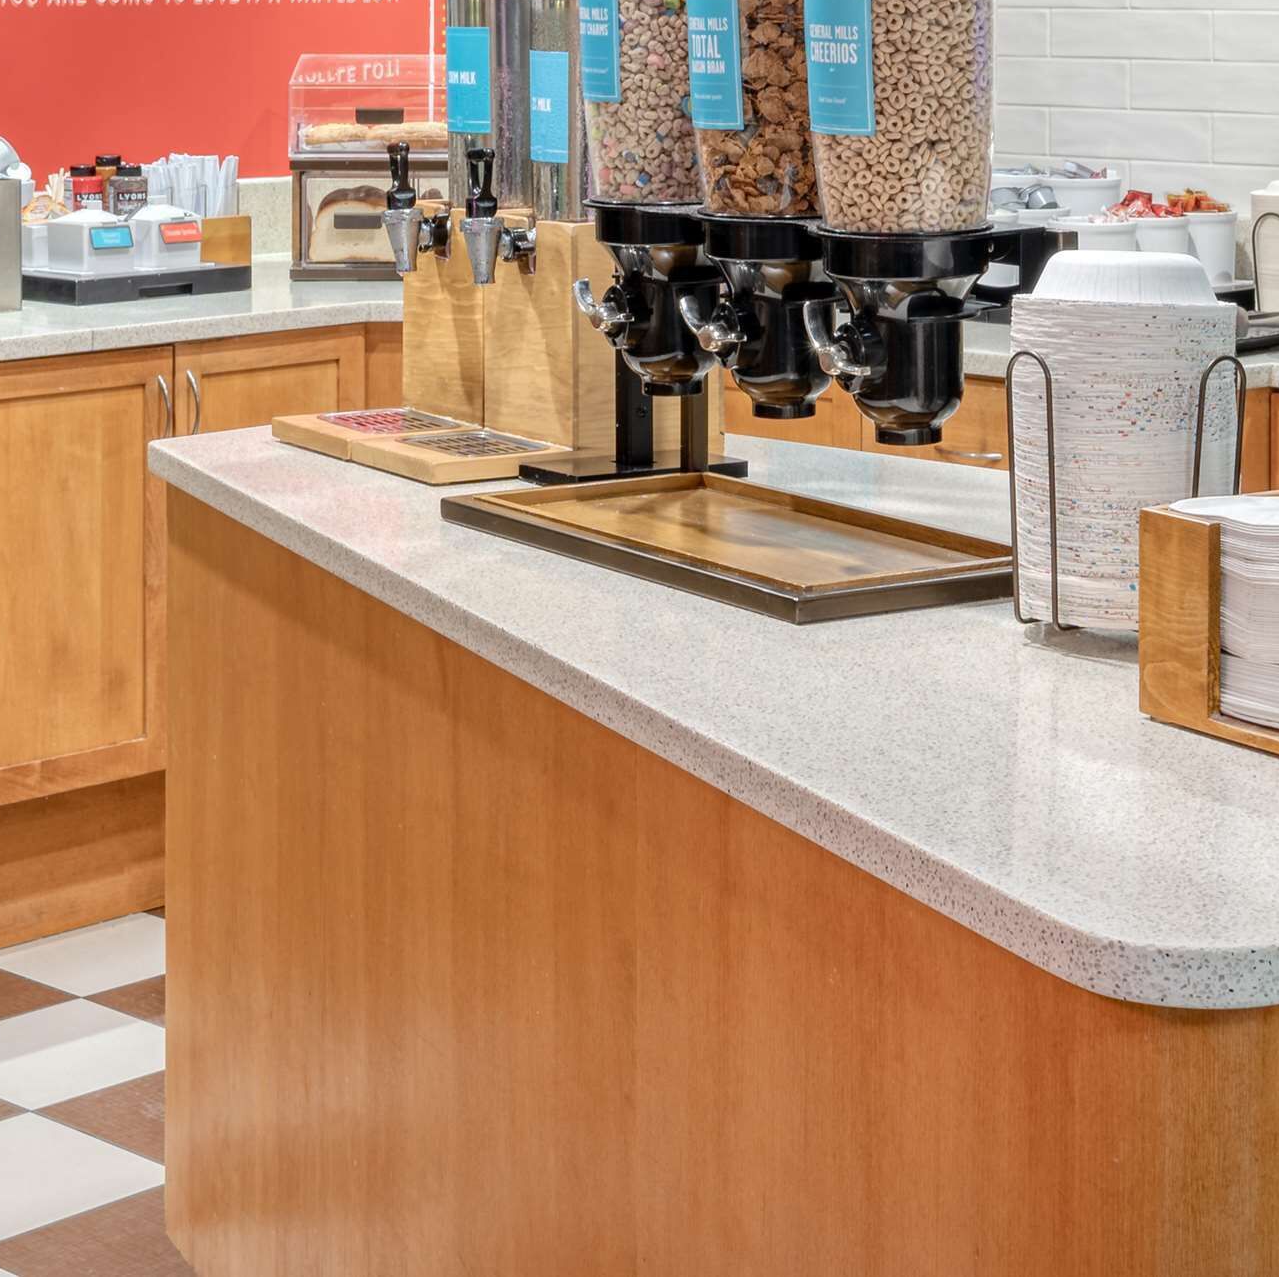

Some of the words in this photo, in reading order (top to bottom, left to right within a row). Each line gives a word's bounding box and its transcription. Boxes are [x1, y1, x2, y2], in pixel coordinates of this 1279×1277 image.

[707, 17, 728, 32] MILLS
[835, 25, 858, 40] MILLS
[692, 35, 721, 59] TOTAL
[707, 60, 725, 74] BRAN
[460, 71, 476, 85] MILK
